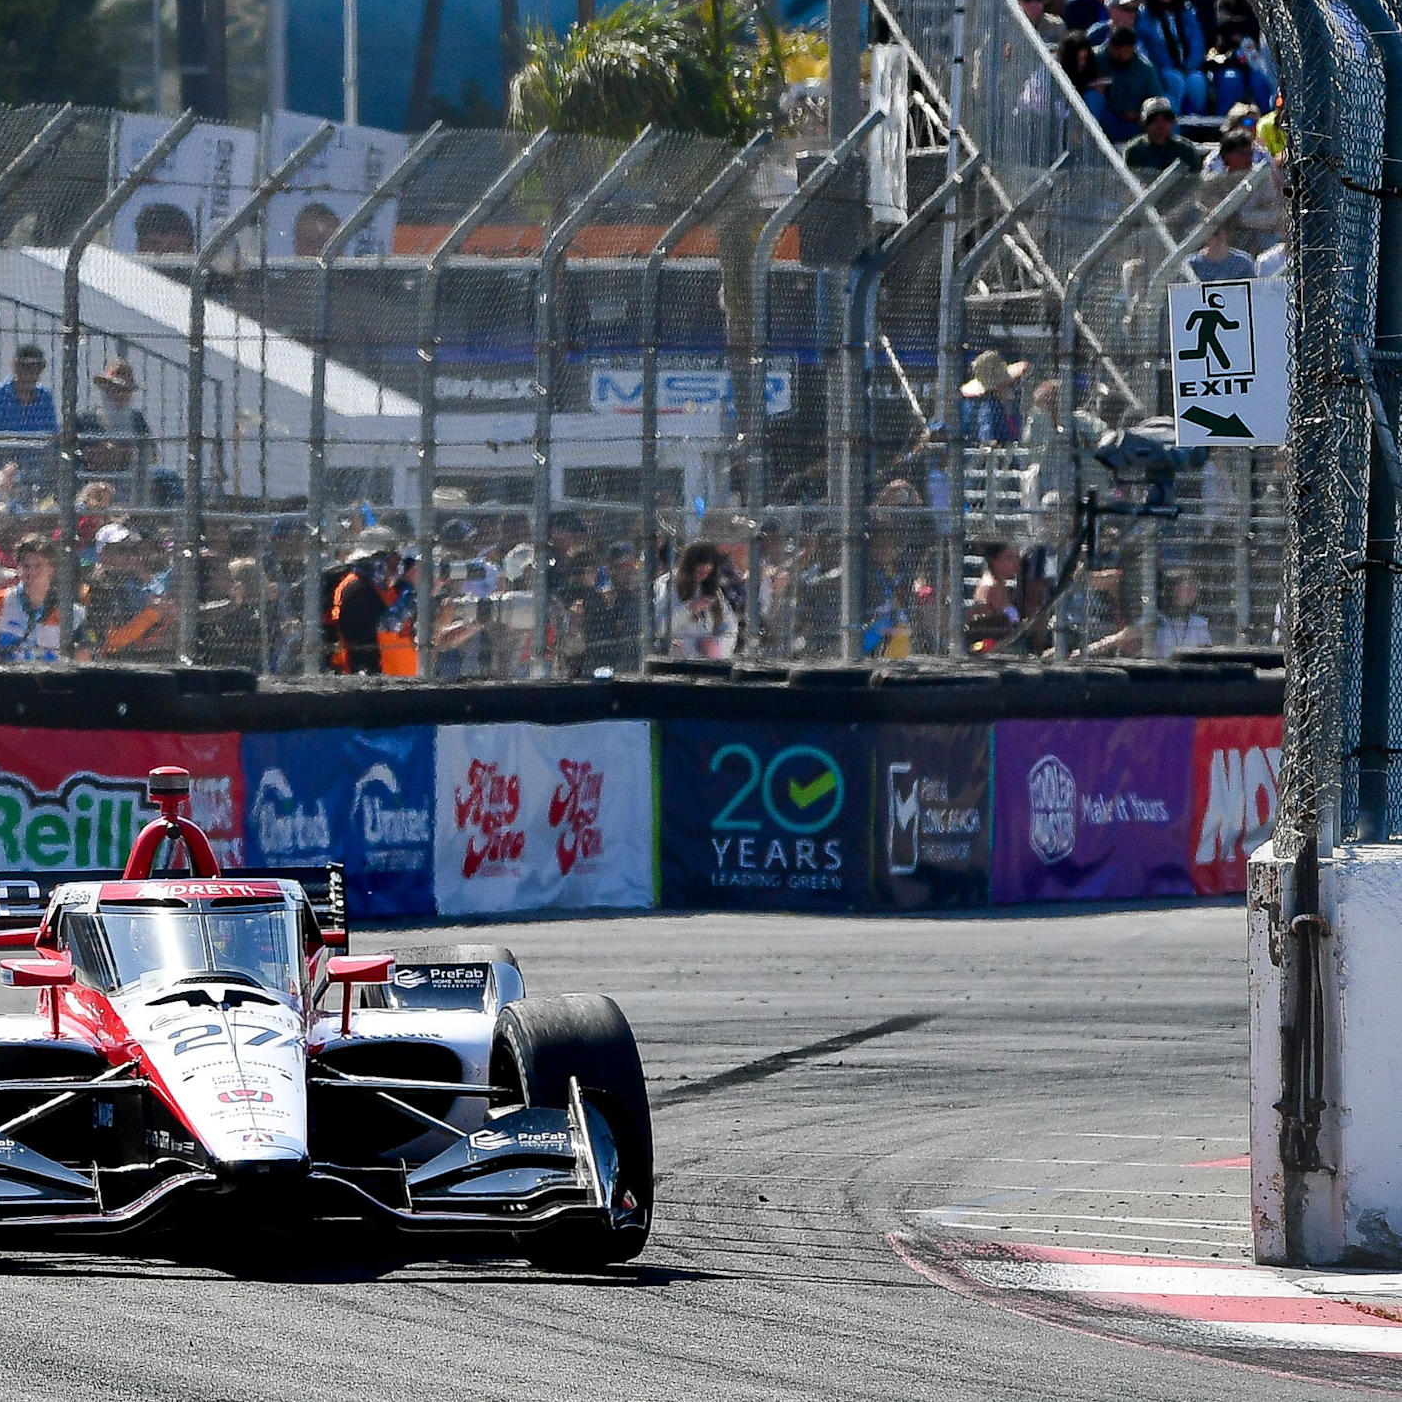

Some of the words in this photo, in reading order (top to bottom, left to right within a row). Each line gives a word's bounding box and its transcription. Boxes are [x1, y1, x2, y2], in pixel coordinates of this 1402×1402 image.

[1179, 378, 1254, 398] EXIT
[709, 743, 845, 834] 20
[711, 838, 843, 870] YEARS
[788, 874, 843, 890] GREEN
[430, 968, 484, 979] PreFab
[168, 1024, 283, 1056] 27
[518, 1132, 567, 1141] PreFab
